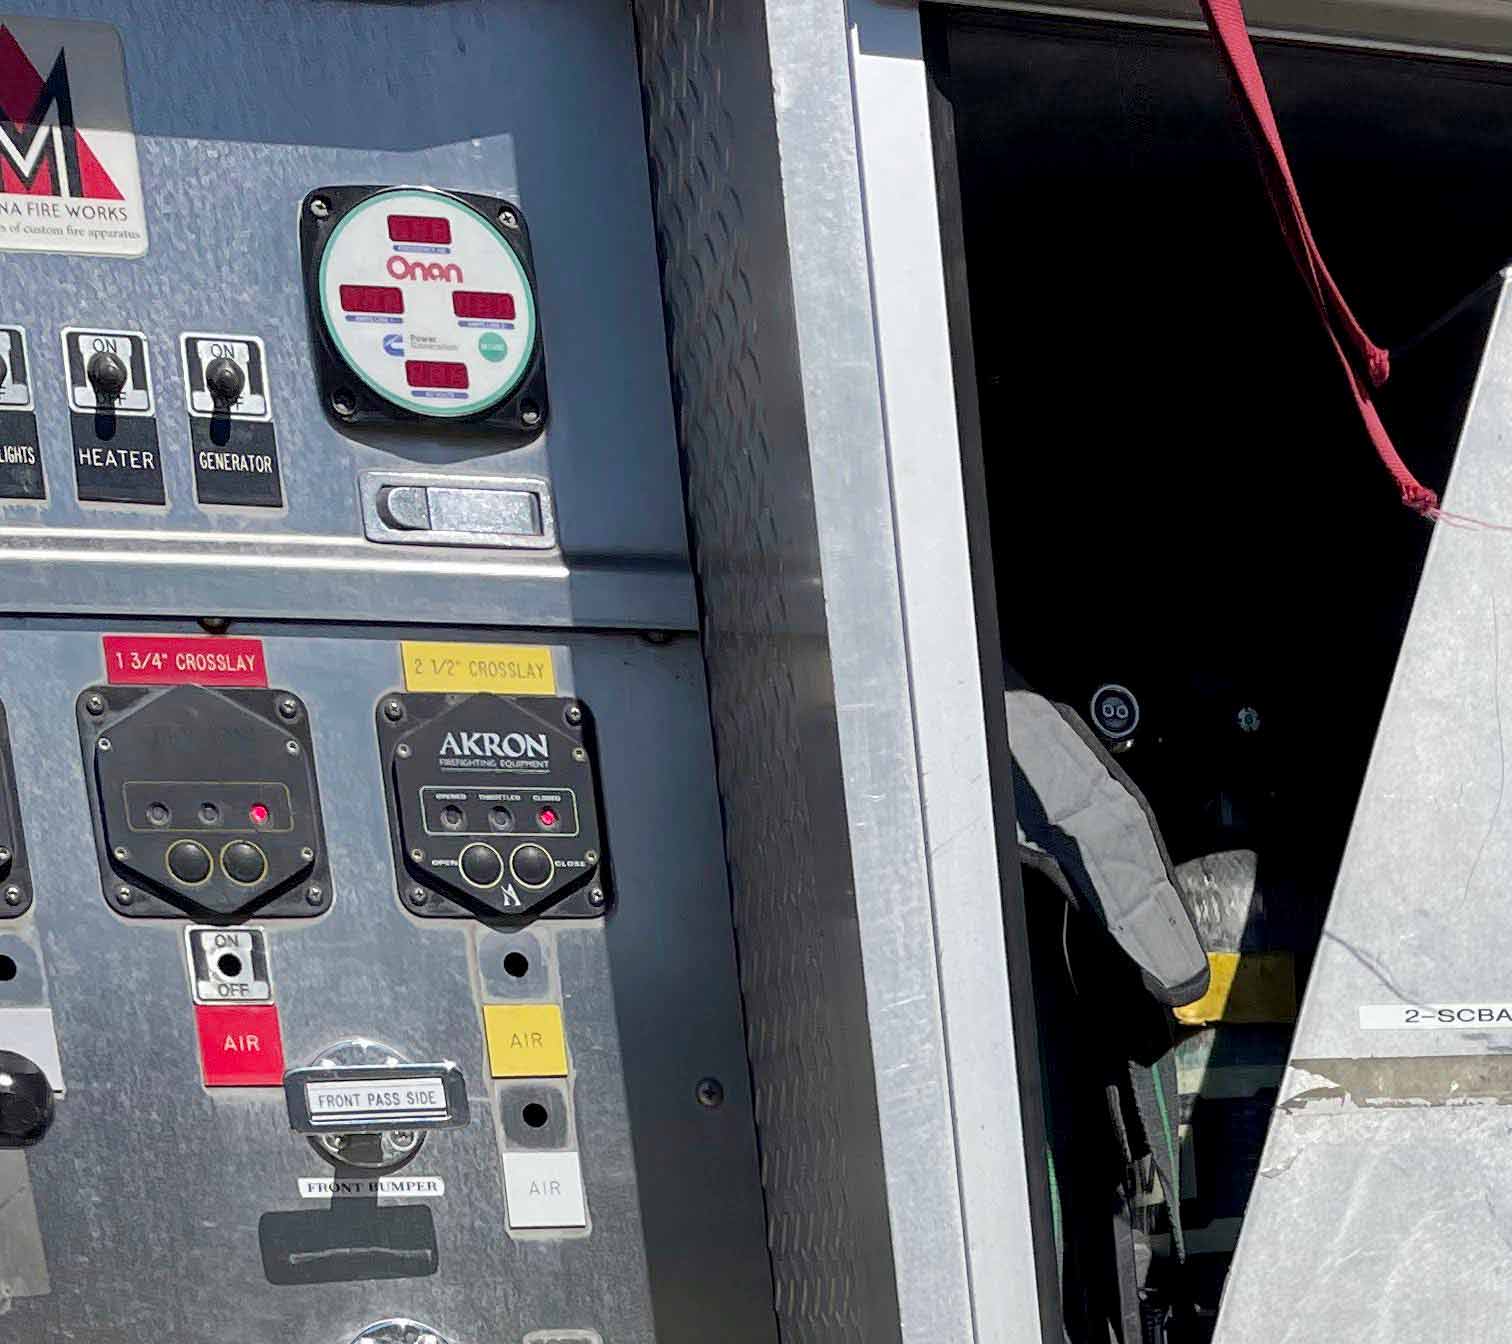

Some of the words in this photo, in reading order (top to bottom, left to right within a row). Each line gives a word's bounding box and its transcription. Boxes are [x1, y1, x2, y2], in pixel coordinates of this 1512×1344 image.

[27, 203, 60, 218] FIRE
[66, 206, 128, 221] WORKS
[24, 225, 63, 236] custom
[88, 229, 141, 241] apparatus
[386, 255, 464, 283] Onan
[92, 338, 117, 354] ON
[210, 343, 235, 359] ON
[79, 448, 155, 470] HEATER
[199, 451, 273, 473] GENERATOR
[175, 653, 256, 672] CROSSLAY
[468, 660, 544, 681] CROSSLAY
[439, 732, 549, 758] AKRON
[439, 758, 497, 768] FIREFIGHTING
[500, 759, 550, 769] EQUIPMENT
[214, 934, 239, 949] ON
[217, 983, 250, 998] OFF
[223, 1034, 262, 1053] AIR
[510, 1031, 545, 1050] AIR
[318, 1093, 361, 1109] FRONT
[367, 1092, 401, 1107] PASS
[407, 1090, 438, 1105] SIDE
[307, 1182, 364, 1194] FRONT
[369, 1180, 439, 1194] BUMPER
[529, 1180, 562, 1196] AIR
